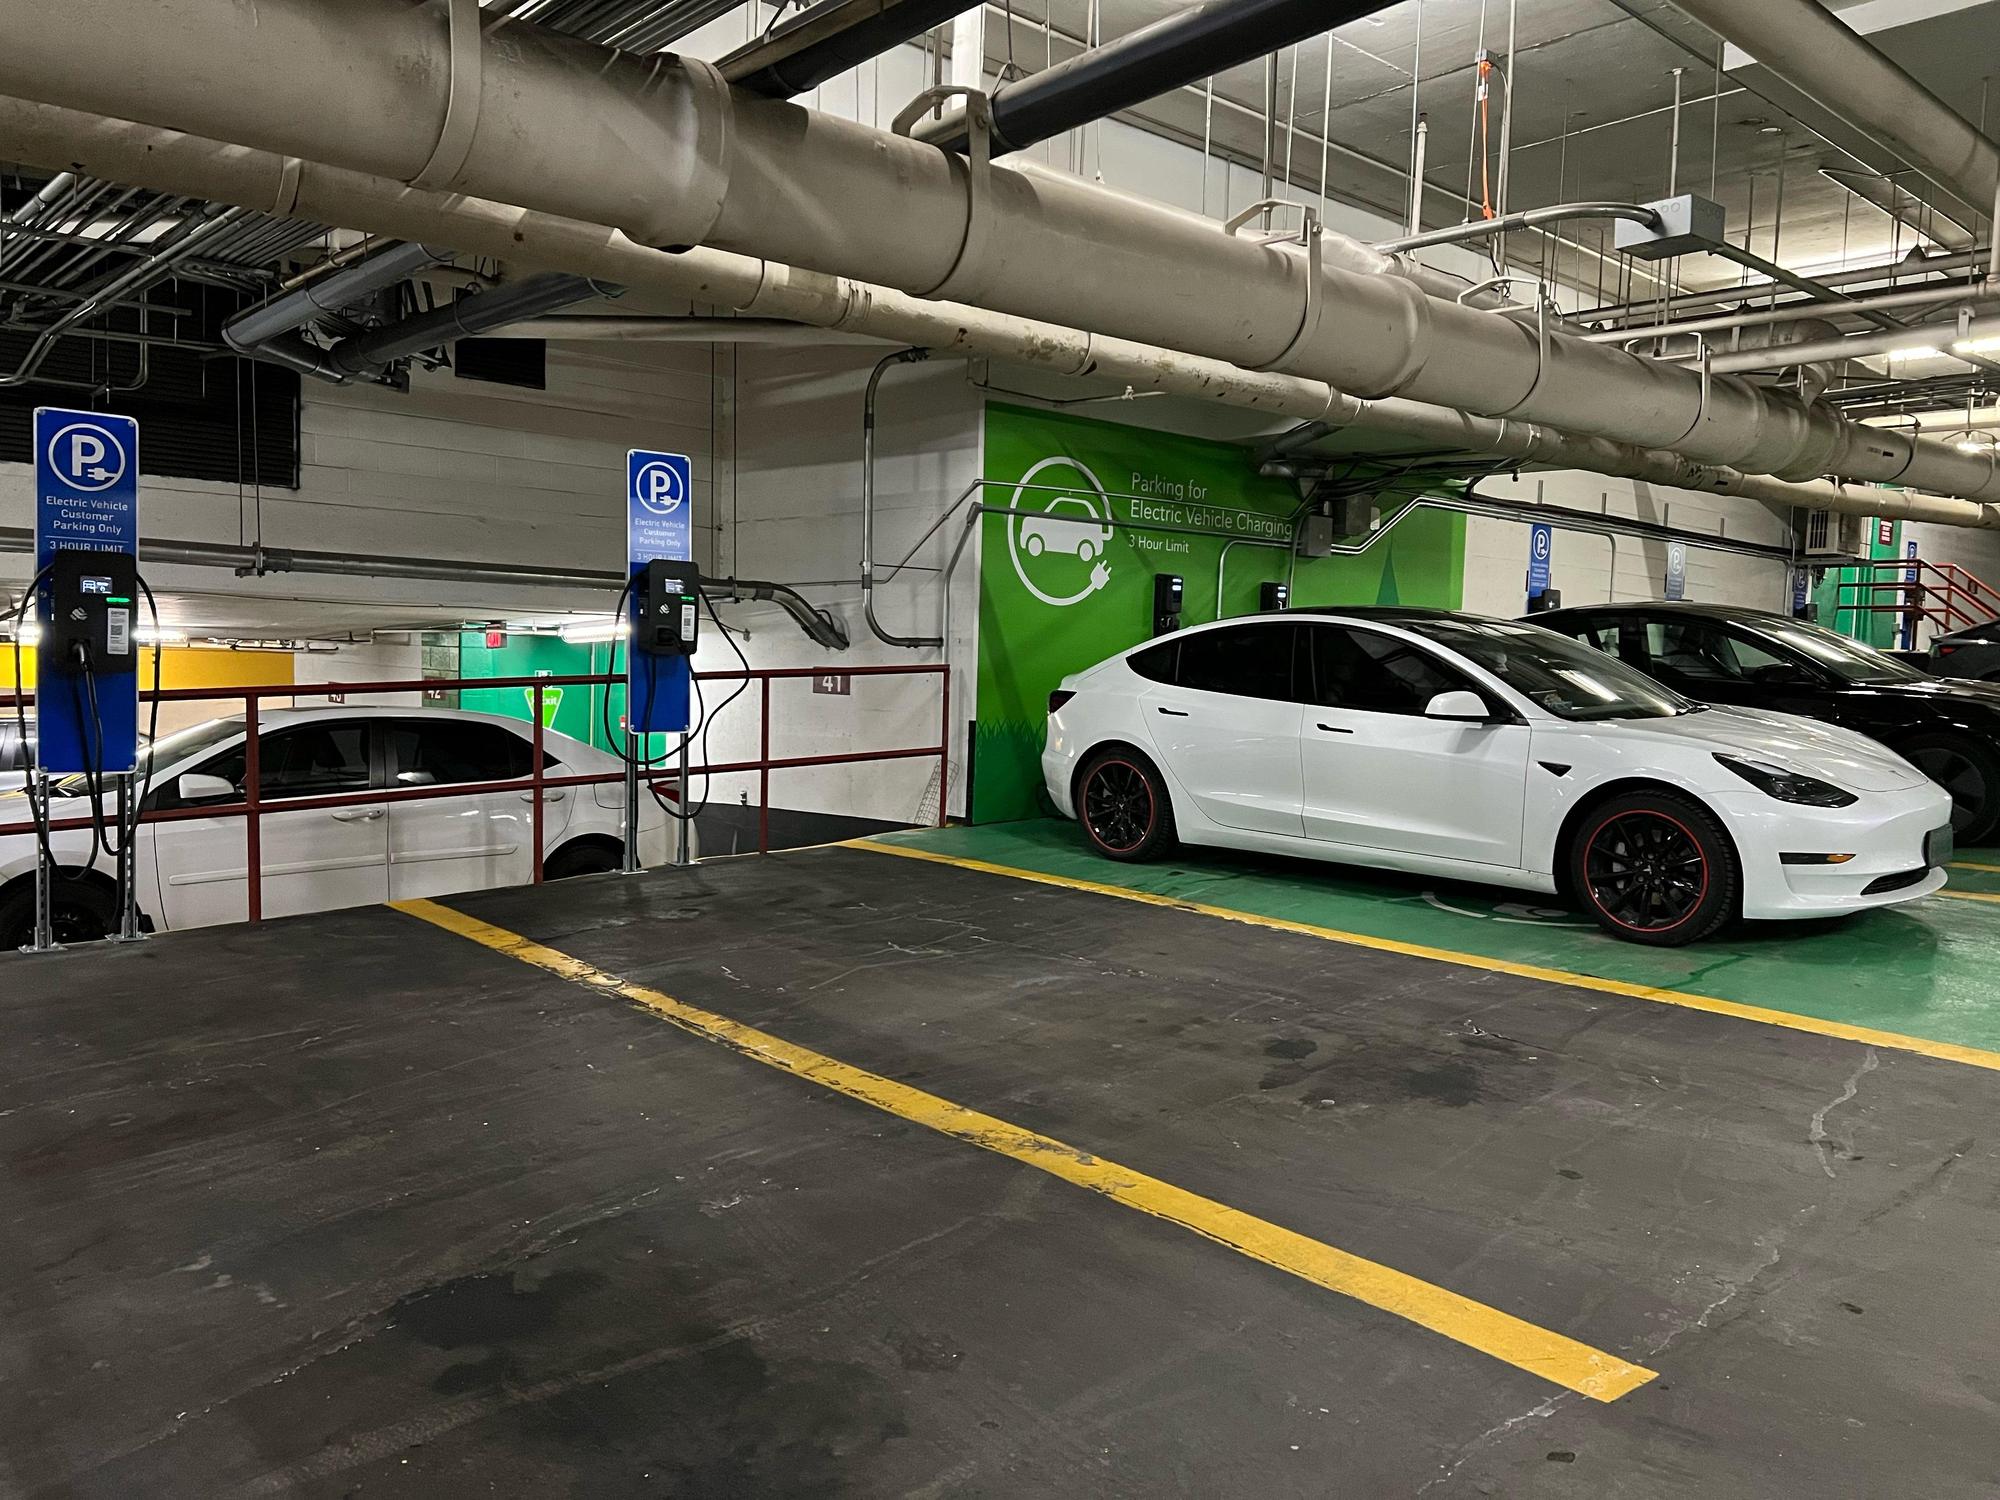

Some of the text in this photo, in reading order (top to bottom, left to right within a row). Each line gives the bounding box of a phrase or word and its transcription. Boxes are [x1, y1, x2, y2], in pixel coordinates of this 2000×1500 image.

[72, 434, 105, 476] P
[650, 470, 671, 503] P
[1132, 472, 1207, 501] Parking for
[46, 495, 128, 511] Electric Vehicle
[61, 509, 114, 521] Customer
[1130, 500, 1292, 538] Electric Vehicle Charging
[53, 520, 122, 535] Parking Only
[634, 518, 685, 529] Electric Vehicle
[643, 528, 676, 537] Customer
[49, 540, 56, 549] 3
[60, 541, 91, 551] HOUR
[639, 536, 681, 549] Parking Only
[1128, 534, 1189, 553] 3 Hour Limit
[823, 676, 841, 692] 41
